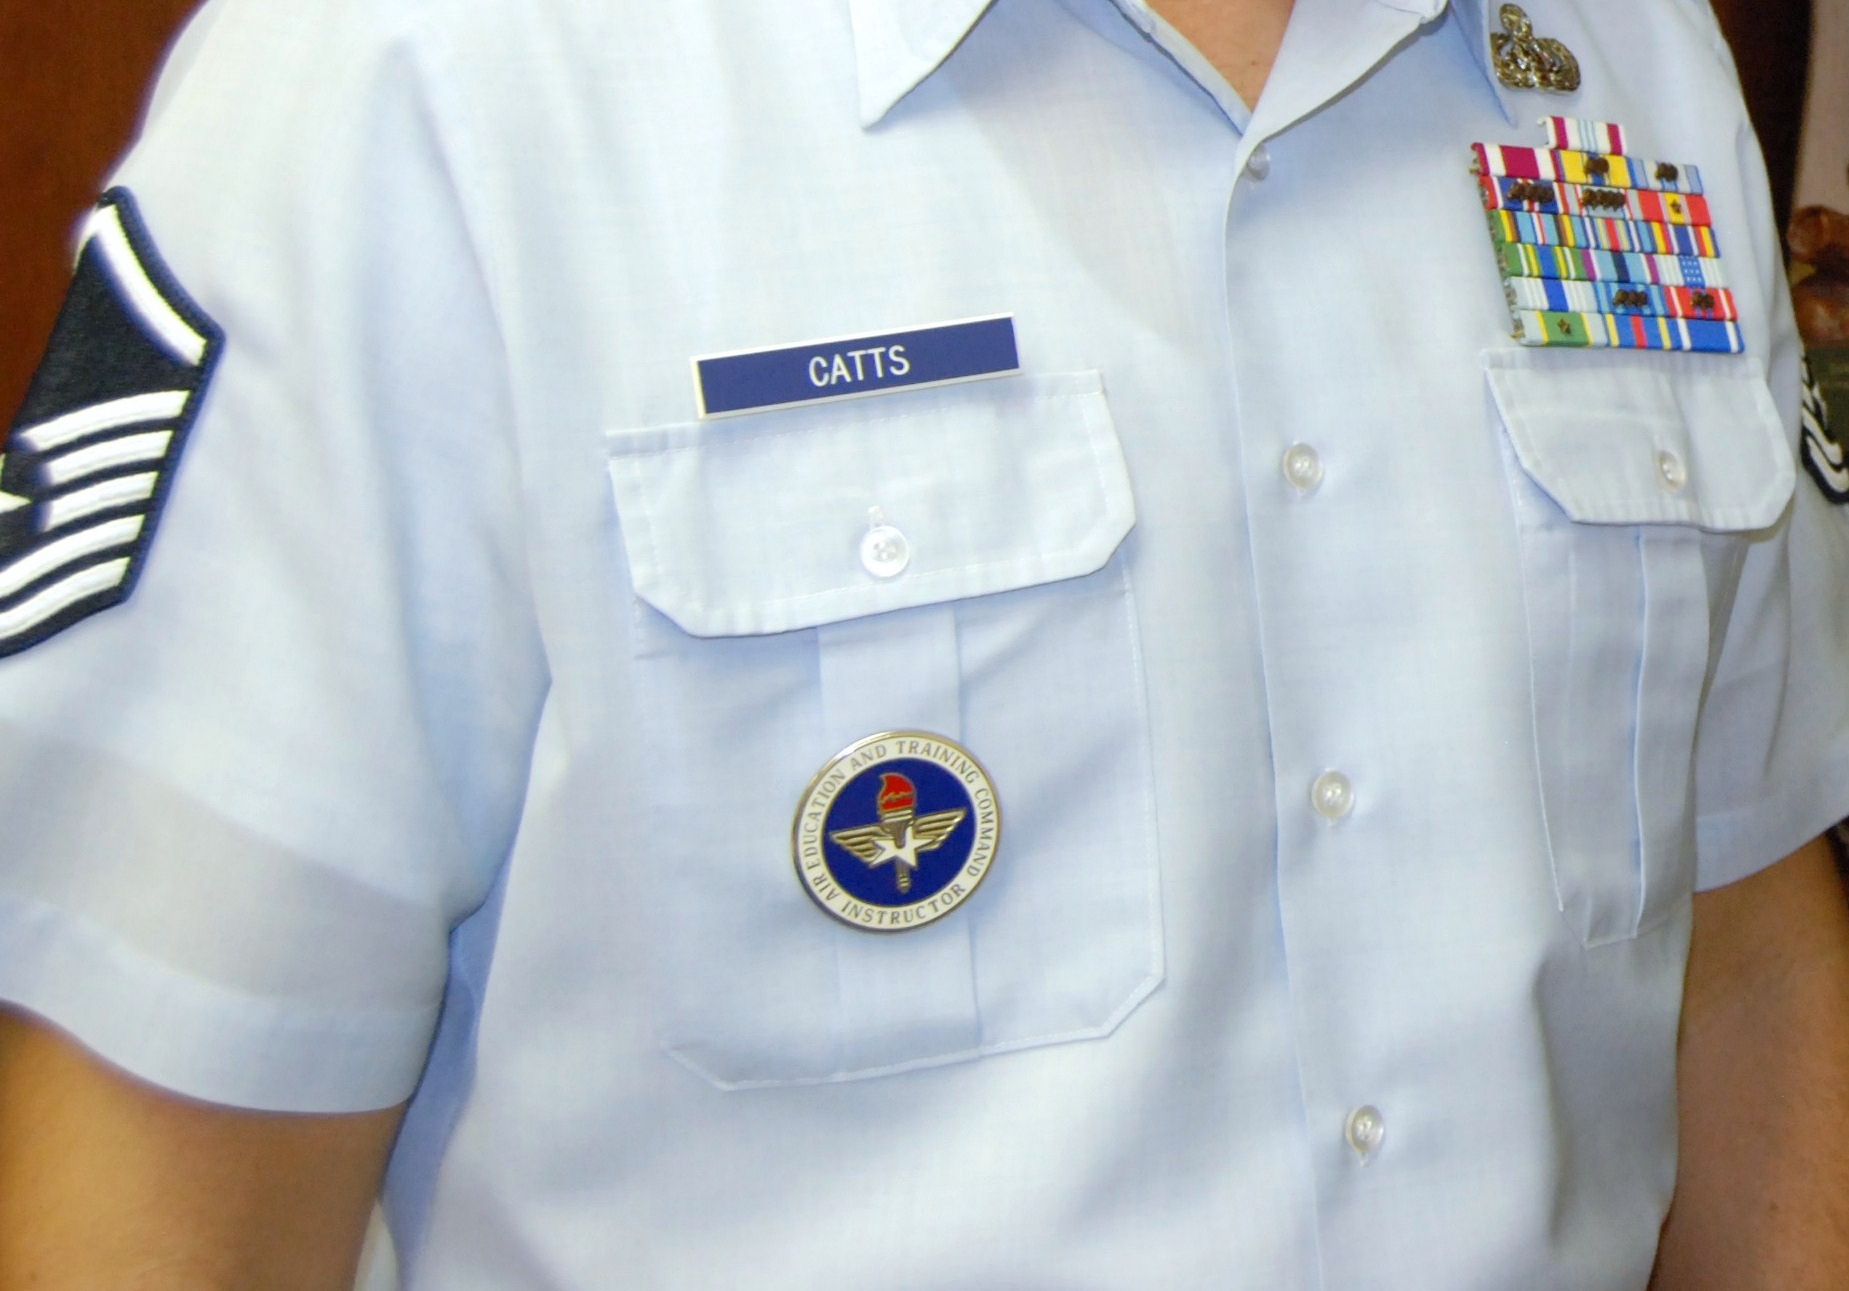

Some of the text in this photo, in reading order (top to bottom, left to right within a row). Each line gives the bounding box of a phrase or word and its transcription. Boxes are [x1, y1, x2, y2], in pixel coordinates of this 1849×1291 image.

[808, 345, 910, 387] CATTS
[803, 740, 995, 902] AIR EDUCATION AND TRAINING COMMAND
[840, 883, 966, 925] INSTRUCTOR
